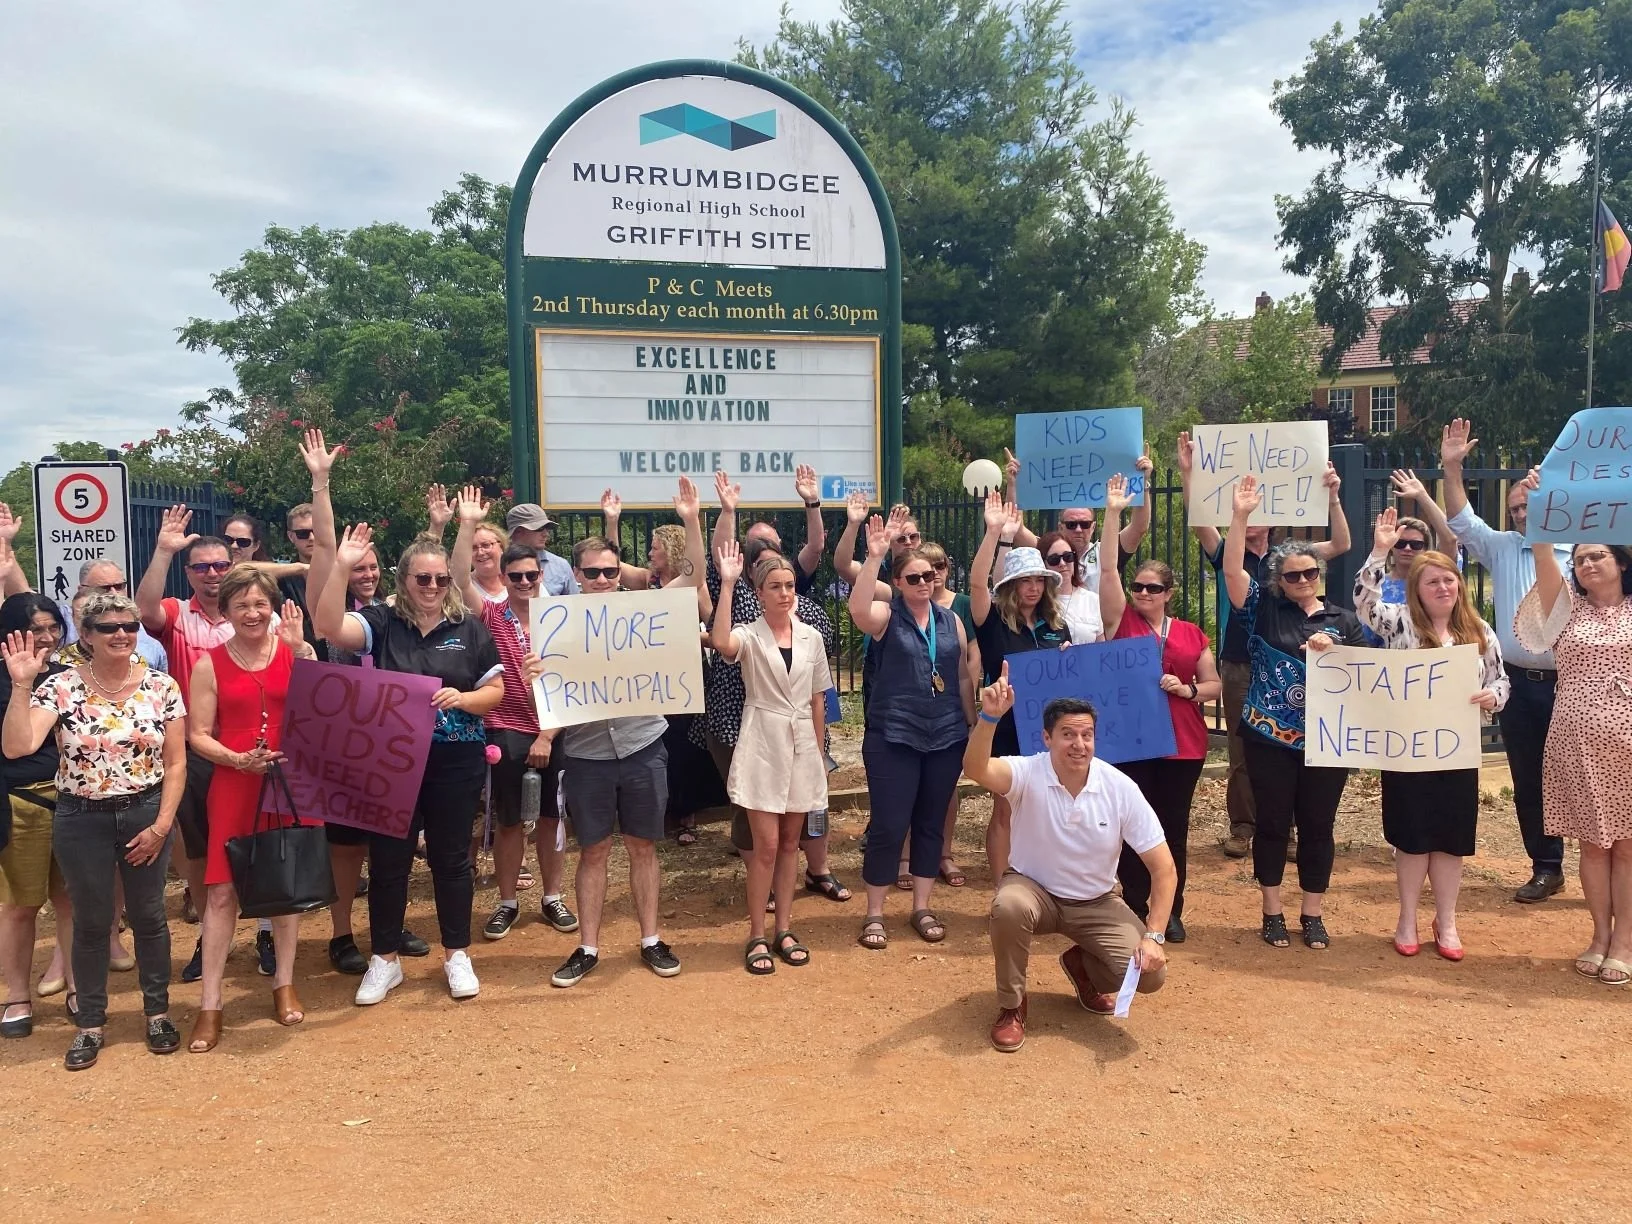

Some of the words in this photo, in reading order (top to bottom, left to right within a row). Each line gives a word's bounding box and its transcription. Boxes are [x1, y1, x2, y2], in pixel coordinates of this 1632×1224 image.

[572, 162, 840, 195] MURRUMBIDGEE
[612, 196, 692, 215] Regional
[700, 200, 741, 219] High
[749, 203, 806, 219] School
[607, 225, 742, 249] GRIFFITH
[751, 231, 811, 251] SITE
[648, 277, 661, 294] P
[667, 279, 684, 296] &
[690, 279, 705, 297] C
[716, 279, 773, 298] Meets
[532, 295, 570, 314] 2nd
[576, 297, 671, 322] Thursday
[677, 301, 719, 320] each
[726, 302, 786, 322] month
[792, 305, 809, 321] at
[814, 303, 879, 326] 6.30pm
[636, 346, 776, 370] EXCELLENCE
[685, 374, 727, 396] AND
[647, 399, 770, 422] INNOVATION
[1045, 415, 1107, 448] KIDS
[1553, 419, 1632, 451] OUR
[619, 451, 722, 474] WELCOME
[740, 451, 795, 473] BACK
[1028, 452, 1104, 483] NEED
[1198, 430, 1239, 474] WE
[1249, 429, 1309, 473] NEED
[74, 488, 89, 509] 5
[1540, 489, 1629, 533] BET
[51, 529, 116, 543] SHARED
[540, 604, 569, 660] 2
[585, 604, 669, 661] MORE
[1025, 653, 1079, 686] OUR
[1100, 647, 1149, 672] KIDS
[1316, 651, 1449, 701] STAFF
[310, 672, 415, 733] OUR
[540, 671, 692, 712] PRINCIPALS
[286, 710, 416, 774] KIDS
[1319, 704, 1460, 760] NEEDED
[293, 750, 391, 798] NEED
